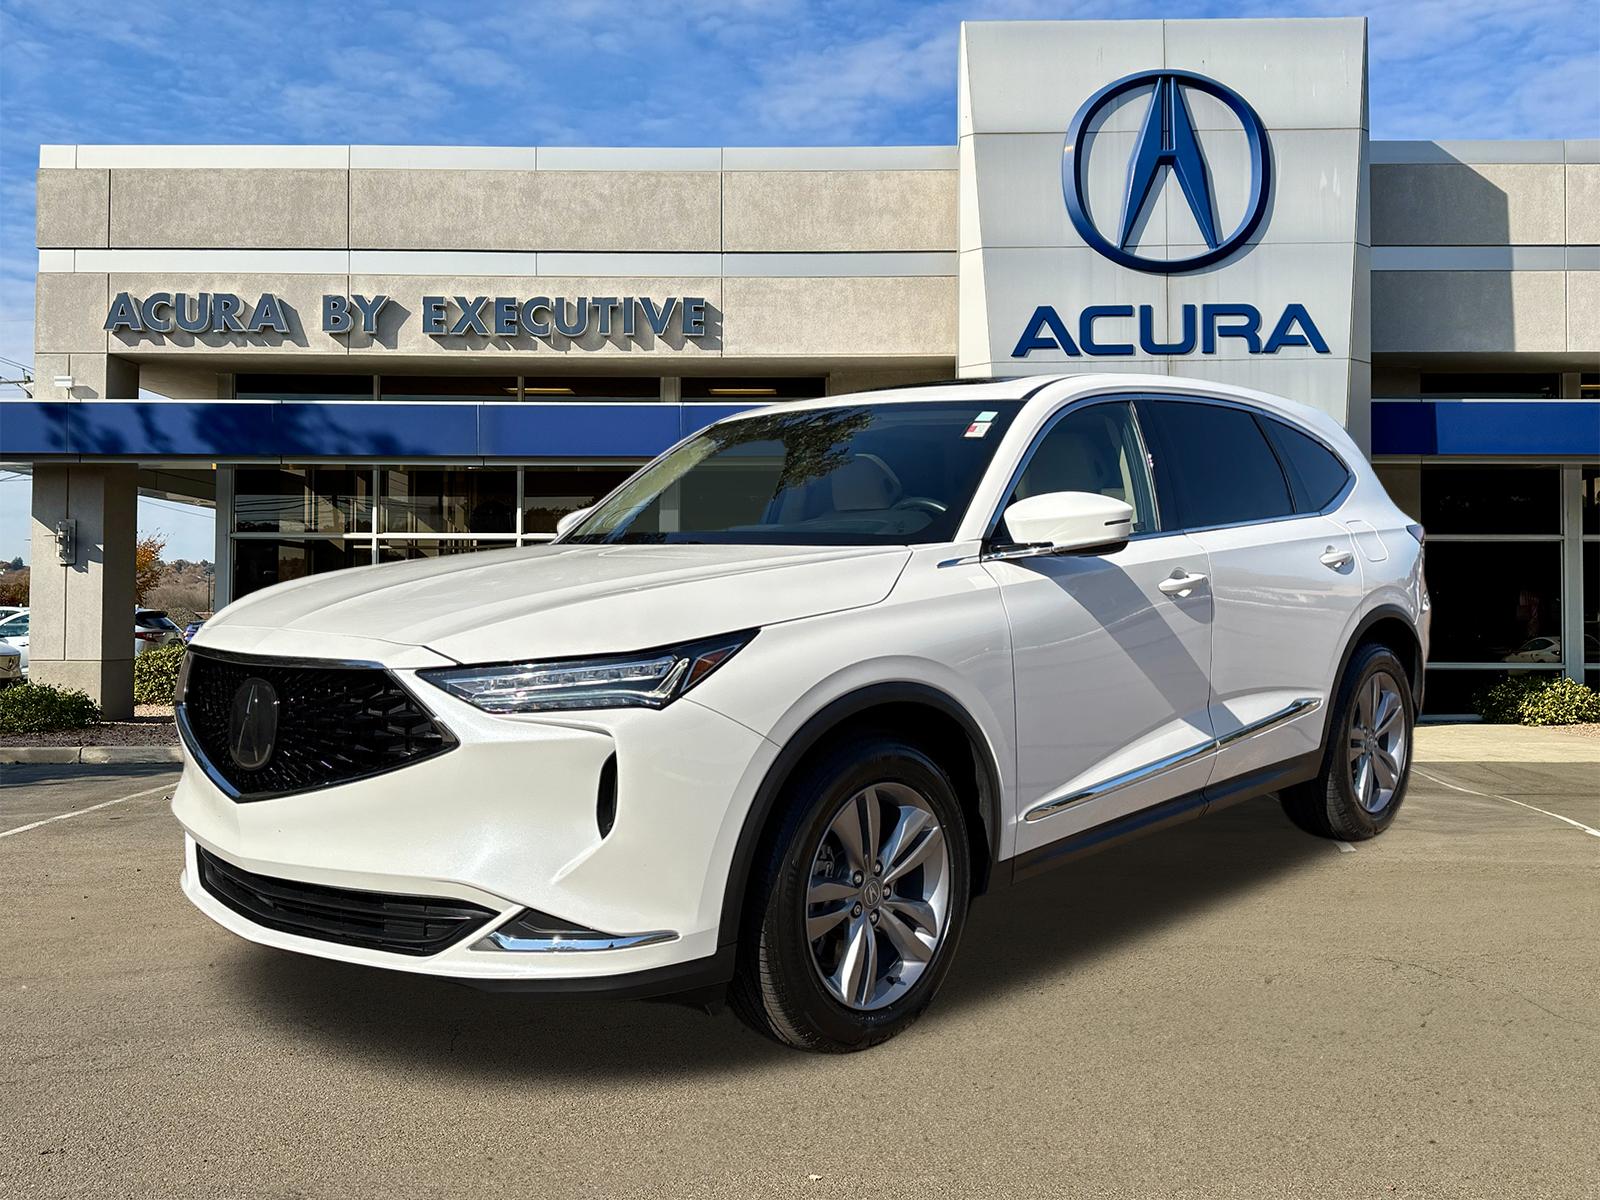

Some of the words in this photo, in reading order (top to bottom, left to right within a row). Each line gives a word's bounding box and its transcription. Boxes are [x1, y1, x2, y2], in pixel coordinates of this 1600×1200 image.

[103, 292, 290, 333] ACURA
[321, 294, 390, 334] BY
[422, 296, 706, 336] EXECUTIVE
[1011, 304, 1332, 357] ACURA
